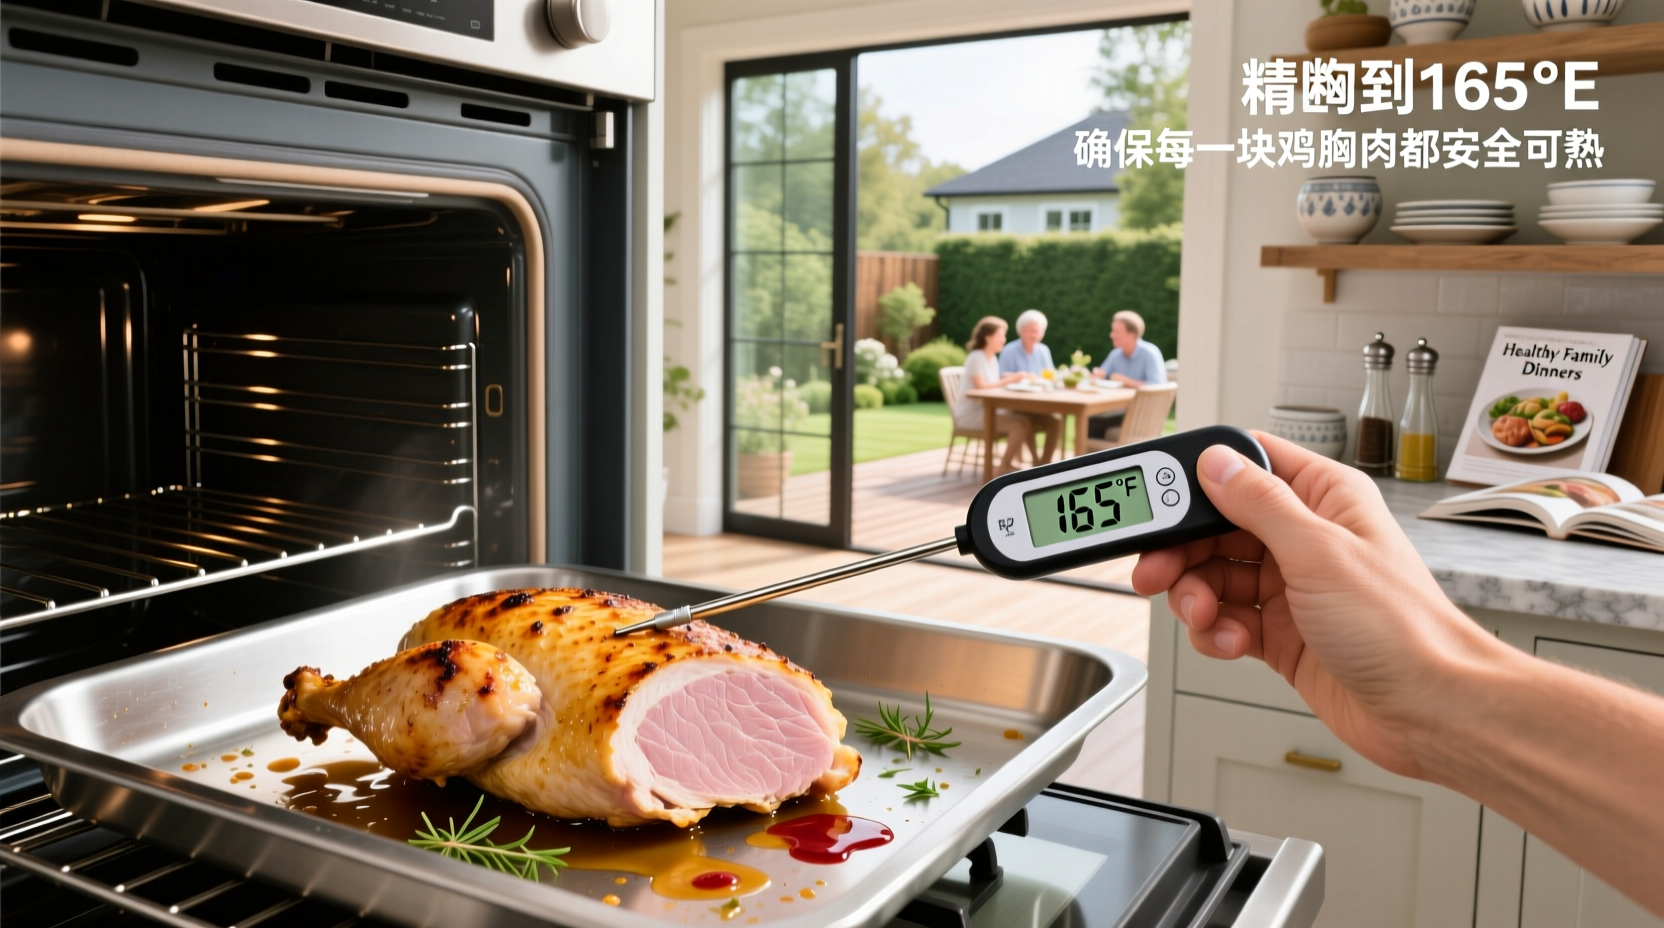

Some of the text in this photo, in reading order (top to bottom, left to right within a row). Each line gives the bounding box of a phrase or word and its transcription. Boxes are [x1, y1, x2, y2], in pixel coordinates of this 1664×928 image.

[1502, 343, 1614, 368] Healthy Family
[1522, 361, 1583, 380] Dinners
